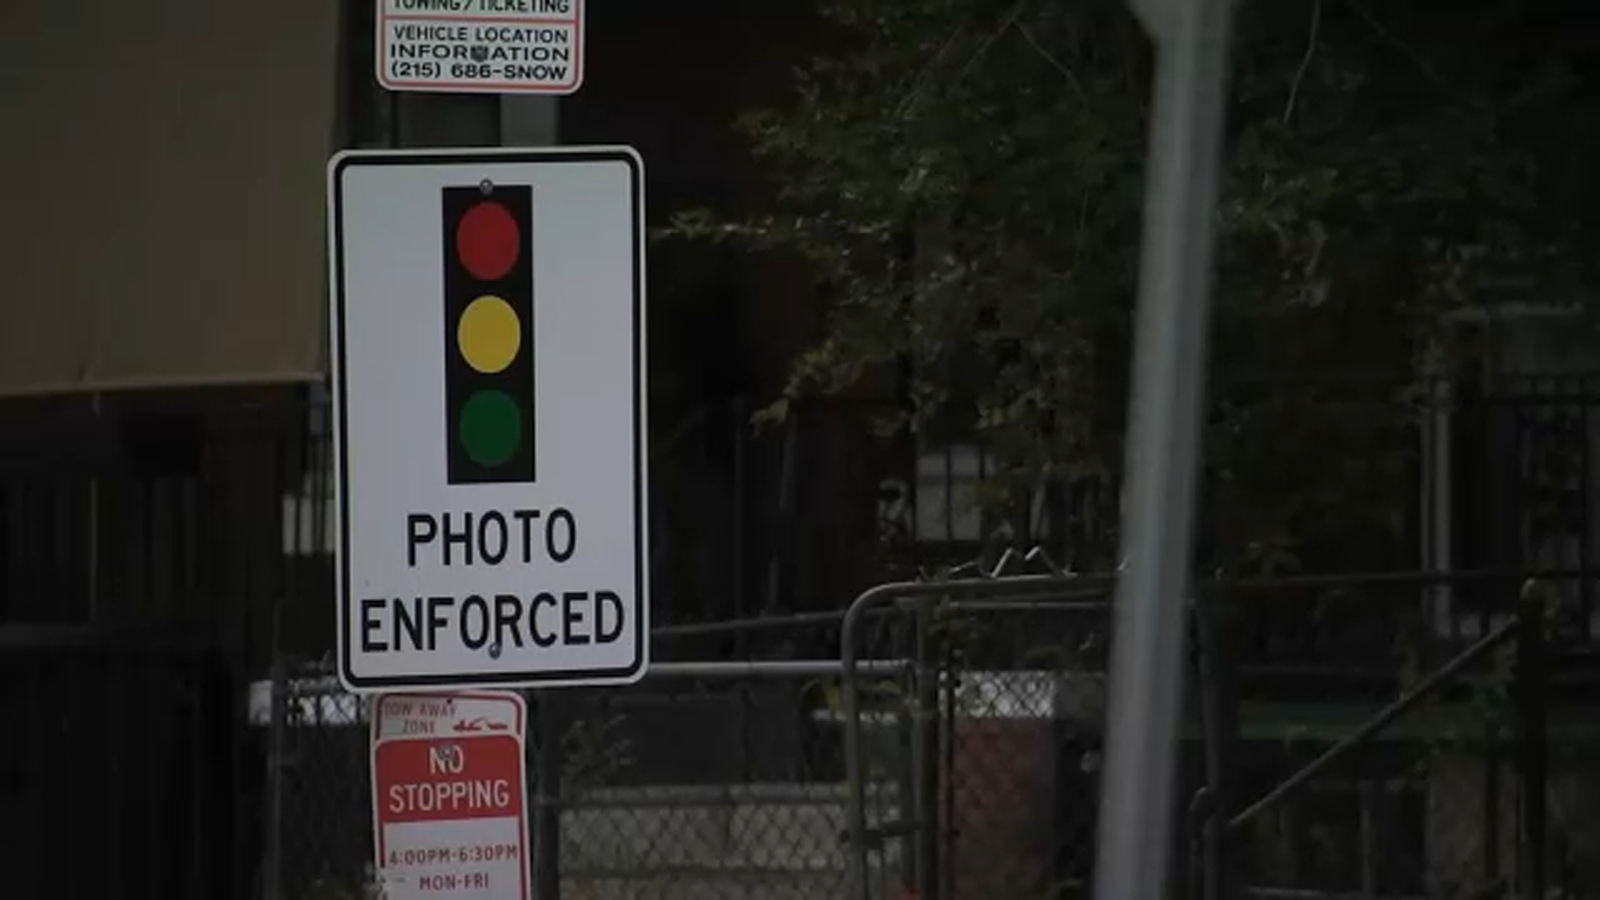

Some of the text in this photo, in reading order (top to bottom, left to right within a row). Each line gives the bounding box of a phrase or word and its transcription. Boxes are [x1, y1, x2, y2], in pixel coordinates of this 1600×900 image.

[394, 26, 568, 43] VEHICLE LOCATION
[391, 44, 569, 61] INFORATION
[391, 62, 567, 80] (215) 686-SNOW
[407, 508, 576, 567] PHOTO
[361, 591, 624, 652] ENFORCED
[385, 703, 457, 717] TOW AWAY
[402, 719, 436, 733] ZONE
[429, 745, 464, 774] NO
[389, 779, 510, 813] STOPPING
[419, 873, 489, 890] MON-FRI
